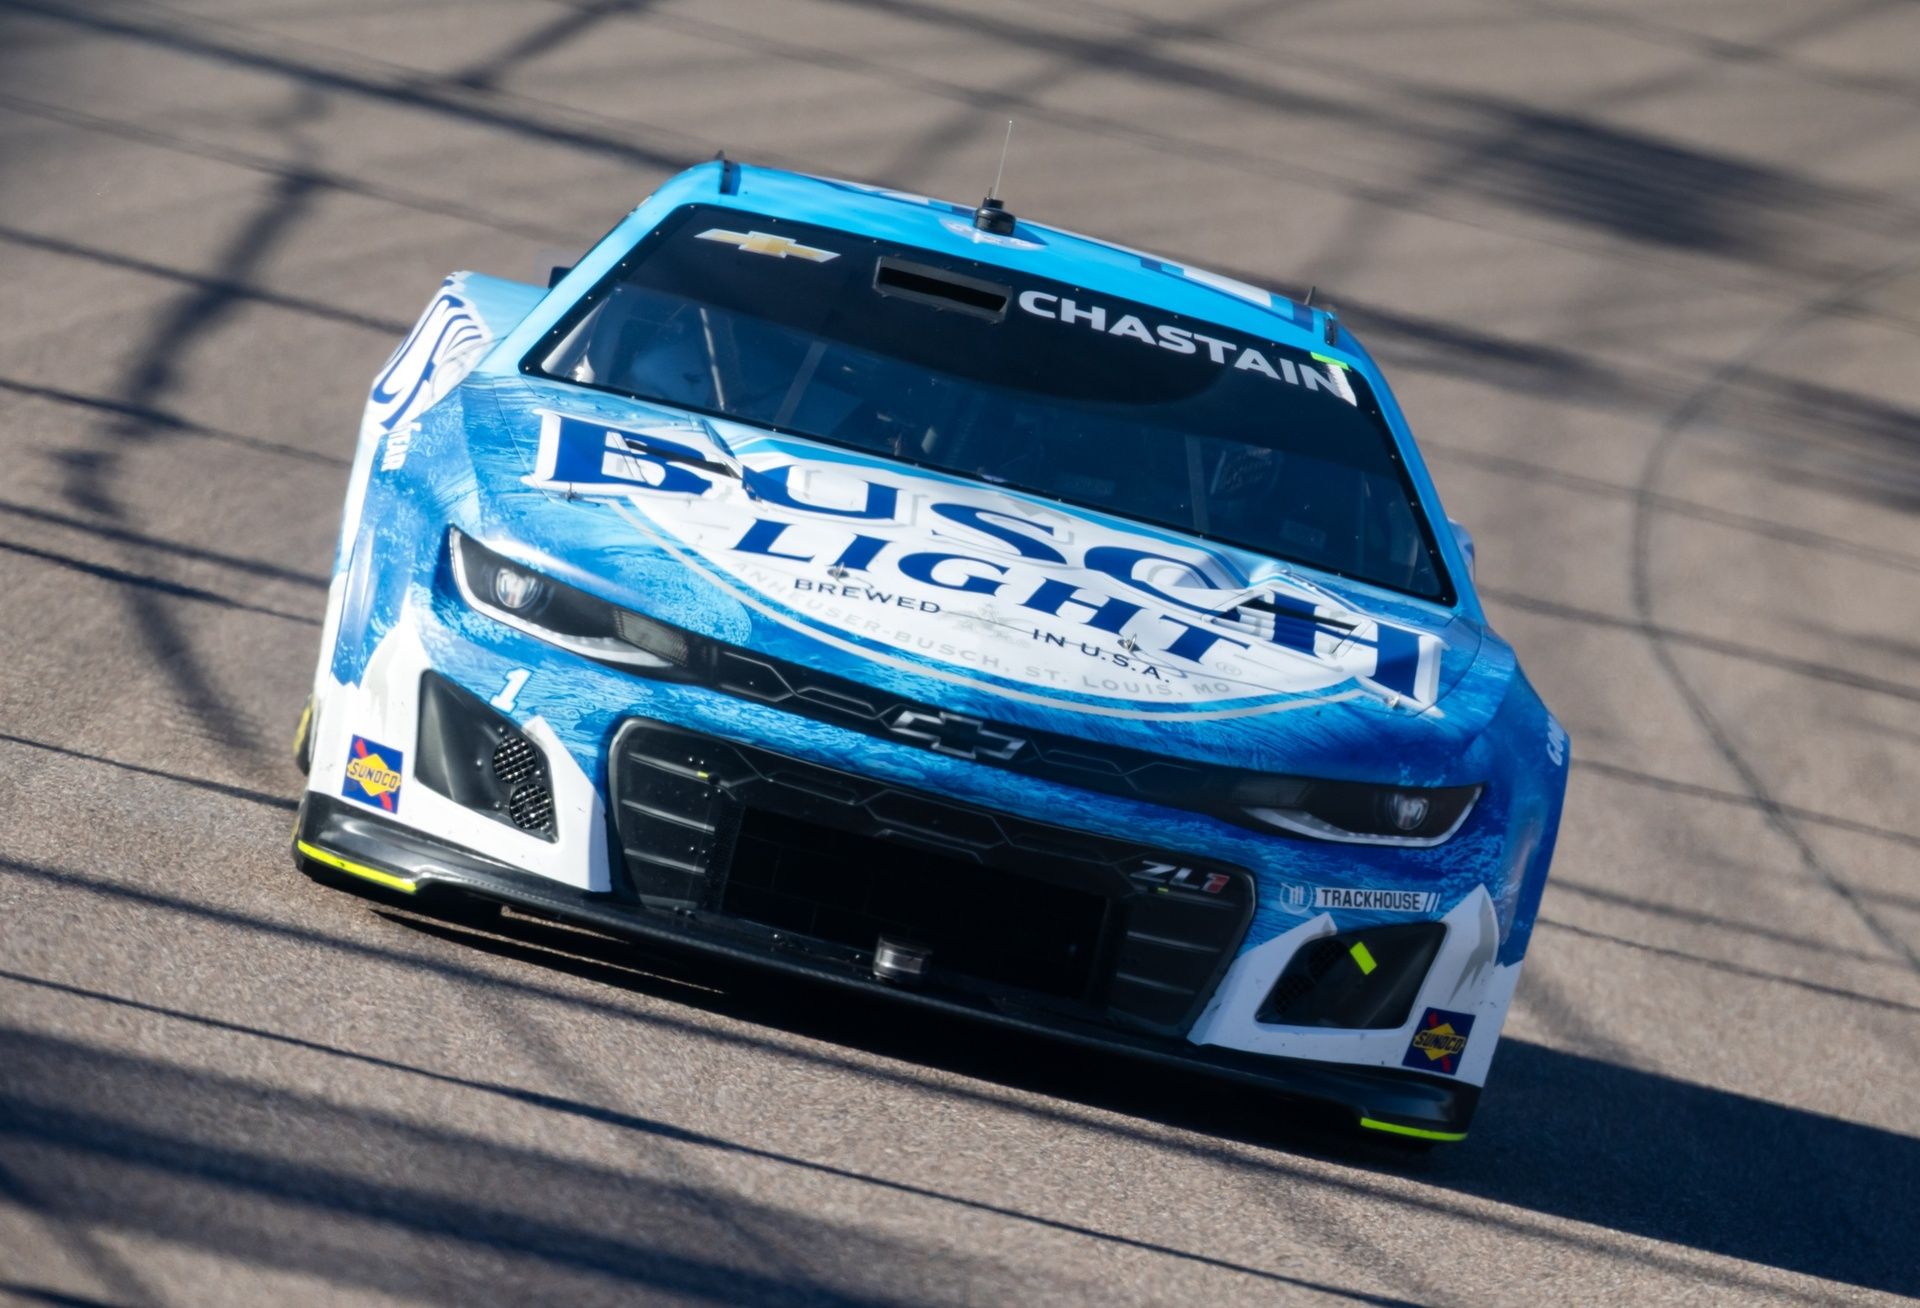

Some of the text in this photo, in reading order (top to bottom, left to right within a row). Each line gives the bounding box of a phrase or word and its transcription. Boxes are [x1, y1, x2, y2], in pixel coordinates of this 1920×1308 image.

[1019, 290, 1357, 407] CHASTAIN
[522, 408, 1442, 715] BUSCH
[732, 518, 1250, 664] LIGHT
[794, 578, 941, 614] BREWED
[1032, 628, 1171, 683] IN U.S.A.
[490, 667, 533, 713] 1
[1025, 665, 1068, 683] ST.
[1082, 674, 1183, 697] LOUIS,
[1192, 682, 1231, 695] MO
[350, 761, 399, 790] SUNOCO
[1129, 860, 1230, 894] ZL1
[1321, 887, 1422, 911] TRACKHOUSE
[1414, 1029, 1465, 1054] SUNOCO
